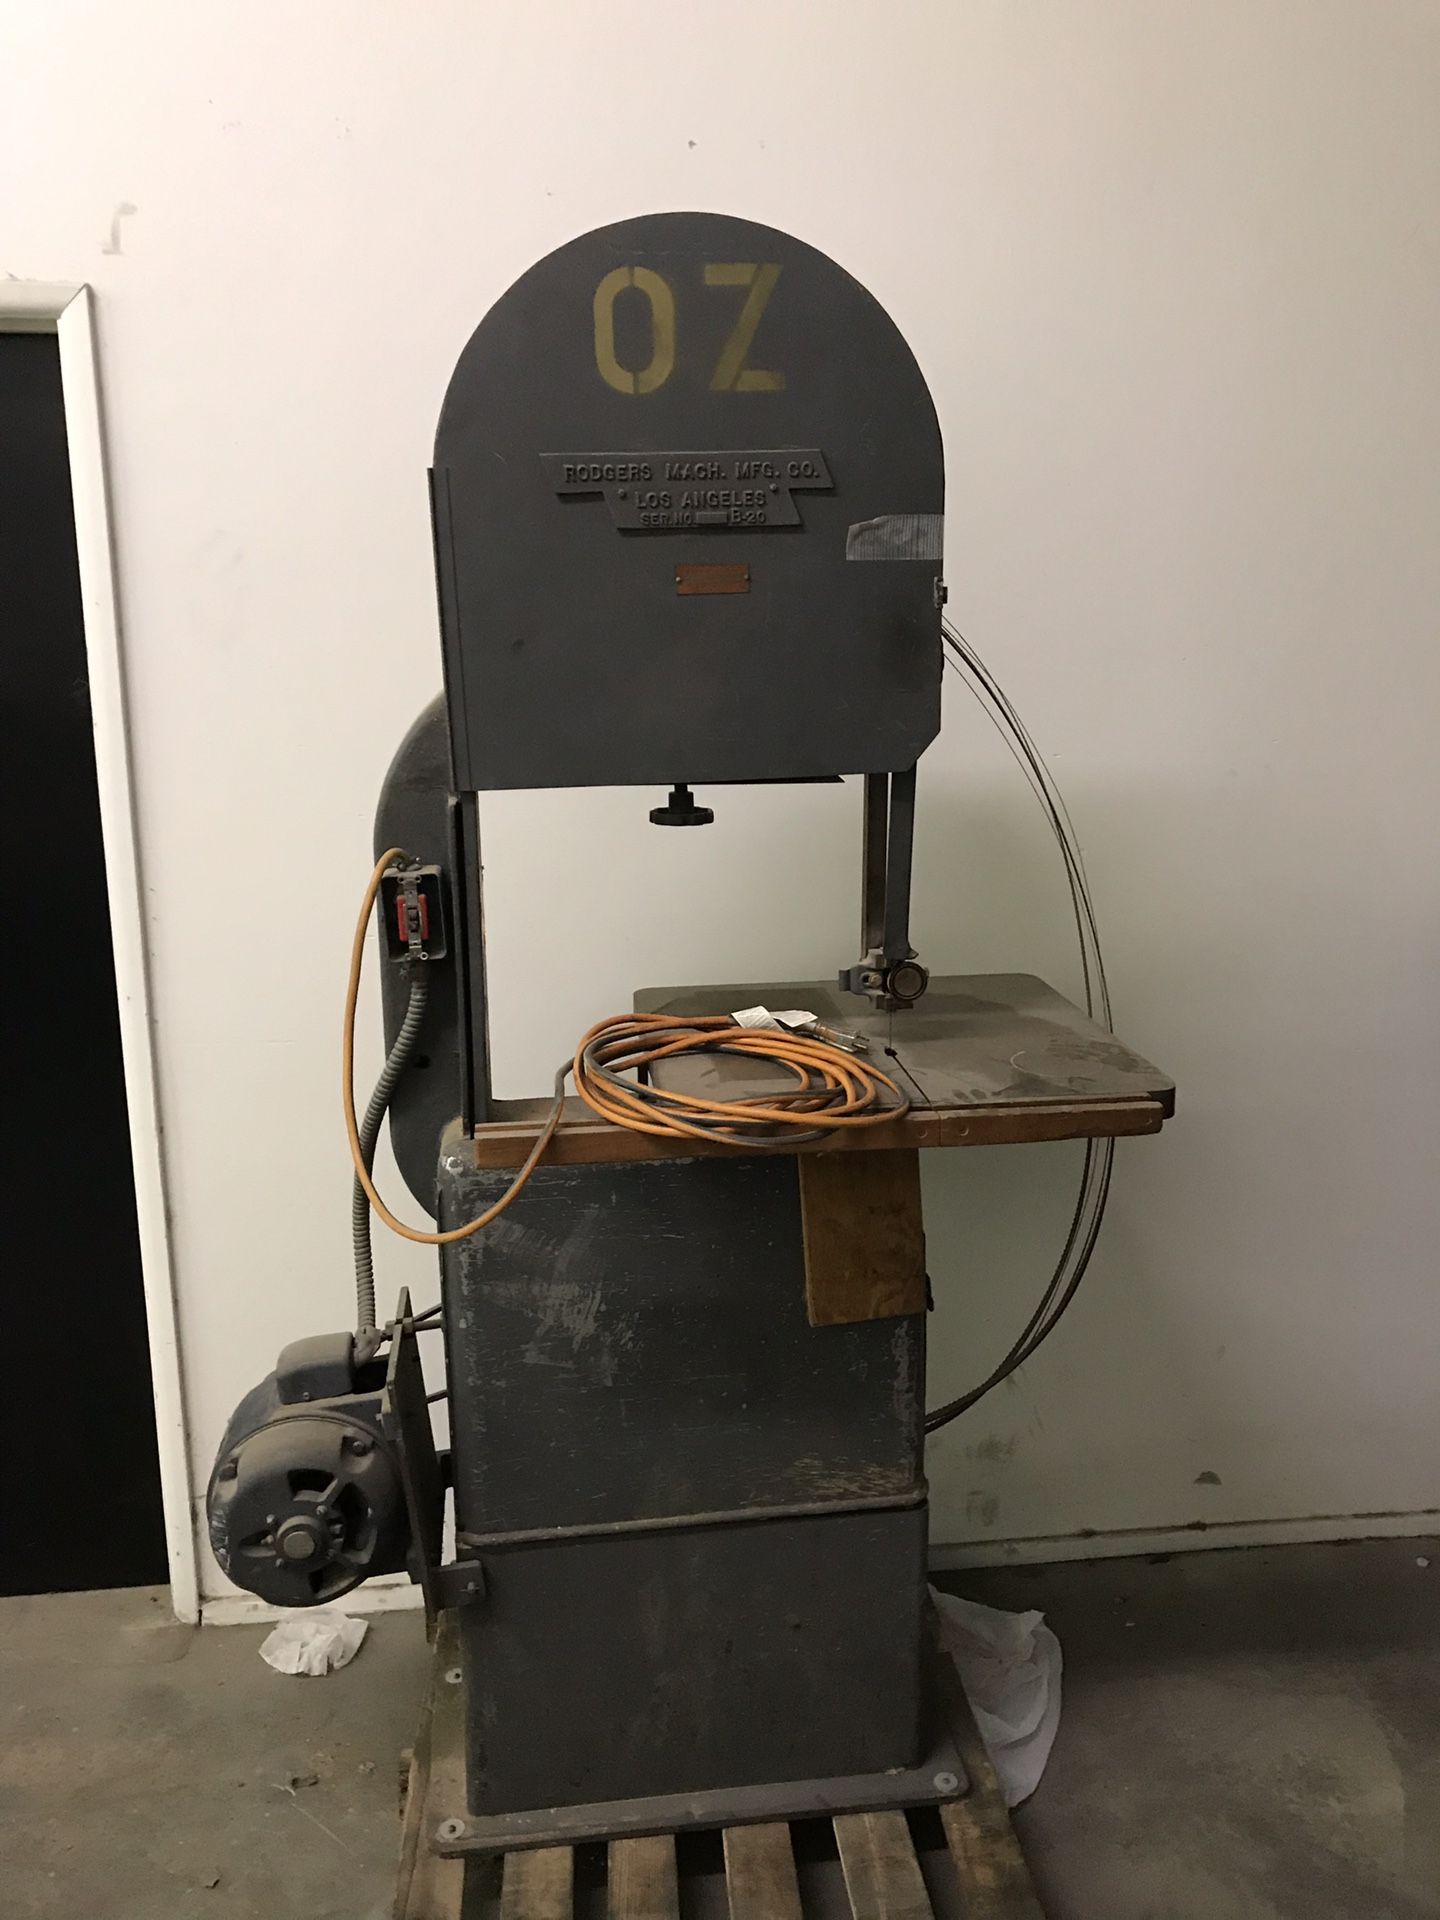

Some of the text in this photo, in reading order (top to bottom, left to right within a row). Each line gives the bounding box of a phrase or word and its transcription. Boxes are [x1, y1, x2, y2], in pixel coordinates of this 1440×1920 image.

[563, 460, 820, 483] RODGERS MACH. MFG. CO.
[635, 490, 767, 509] LOS ANGELES
